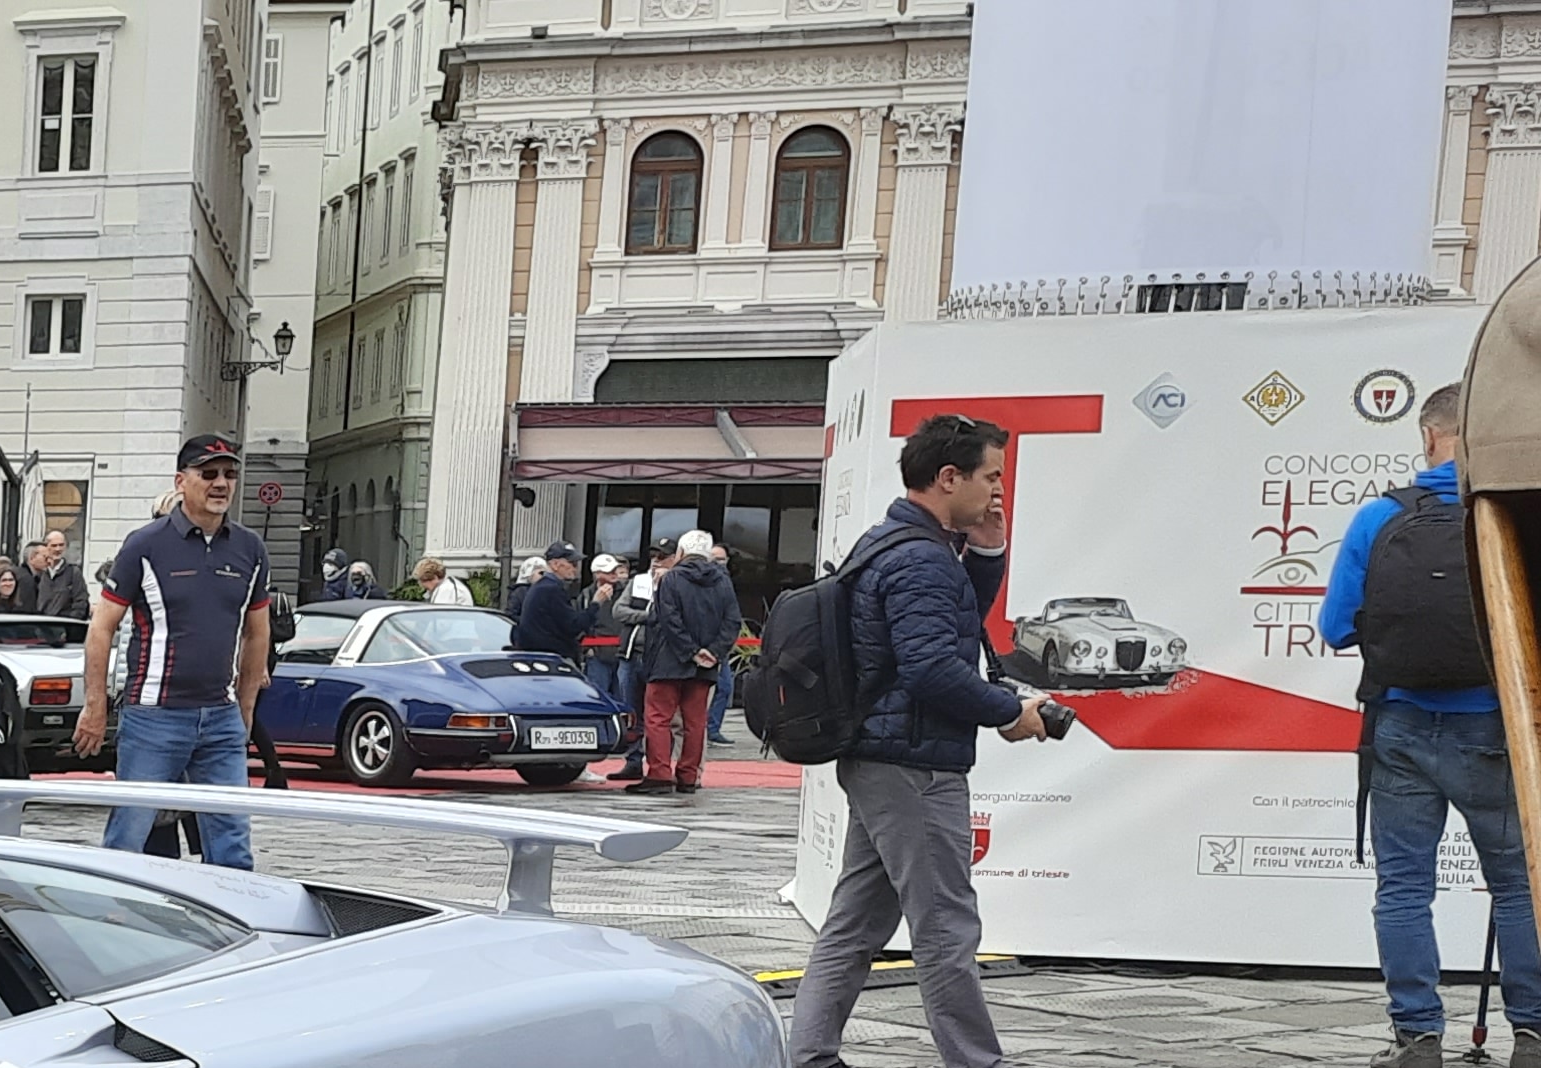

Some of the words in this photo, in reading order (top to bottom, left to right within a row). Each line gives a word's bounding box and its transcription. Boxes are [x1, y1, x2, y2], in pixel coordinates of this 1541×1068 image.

[1152, 392, 1185, 408] ACI
[1252, 796, 1278, 806] Con
[1292, 797, 1355, 809] patrocinio
[1253, 845, 1306, 856] REGIONE
[1252, 857, 1288, 868] FRIULI
[1294, 859, 1344, 869] VENEZIA
[1018, 868, 1028, 878] di
[1031, 869, 1070, 879] trieste
